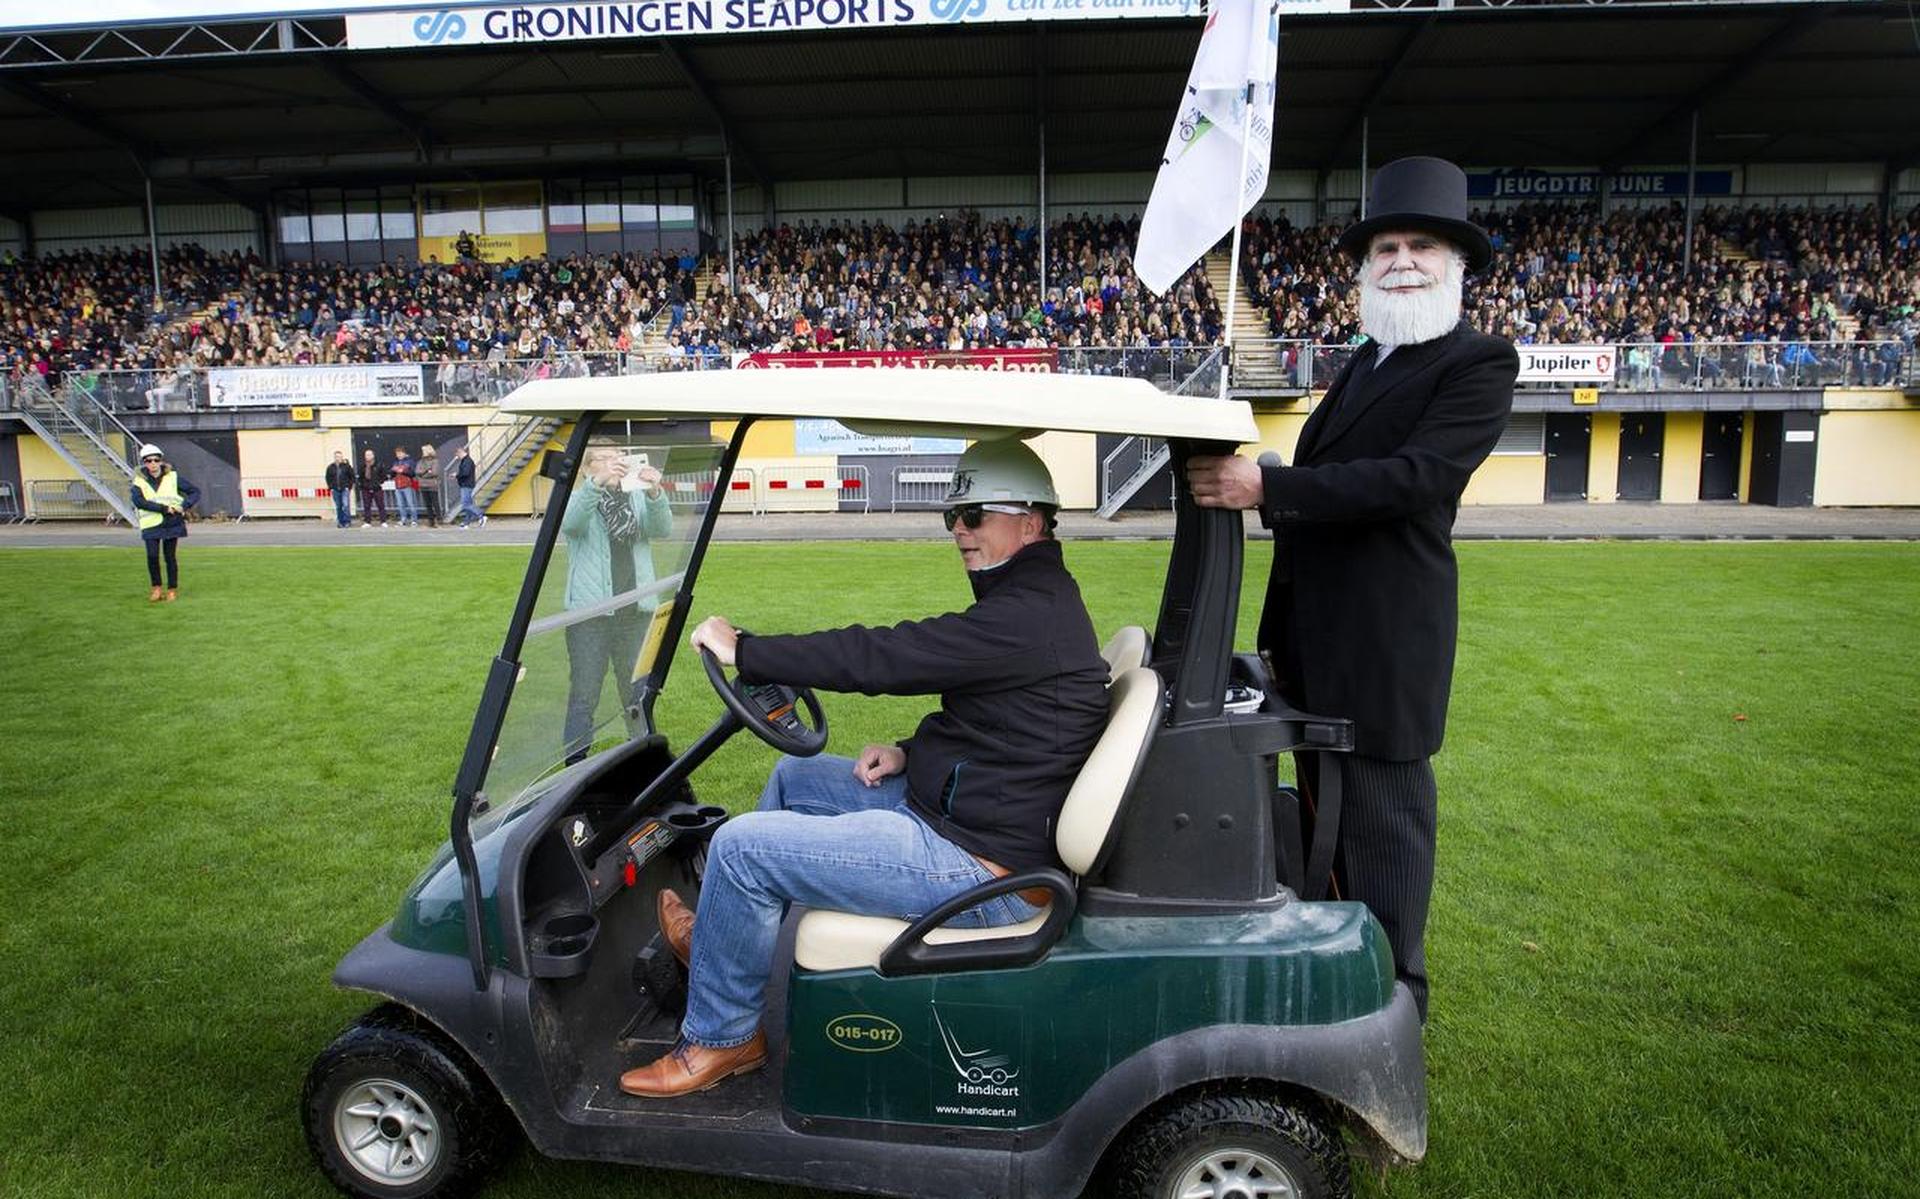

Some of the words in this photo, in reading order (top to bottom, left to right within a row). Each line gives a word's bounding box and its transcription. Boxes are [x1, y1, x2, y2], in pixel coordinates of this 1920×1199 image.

[484, 2, 713, 39] GRONINGEN
[726, 0, 915, 28] SEAPORTS
[1526, 354, 1591, 373] Jupiler
[835, 1026, 896, 1041] 015-017
[958, 1082, 1020, 1097] Handicart
[935, 1104, 1016, 1118] www.handicart.nl
